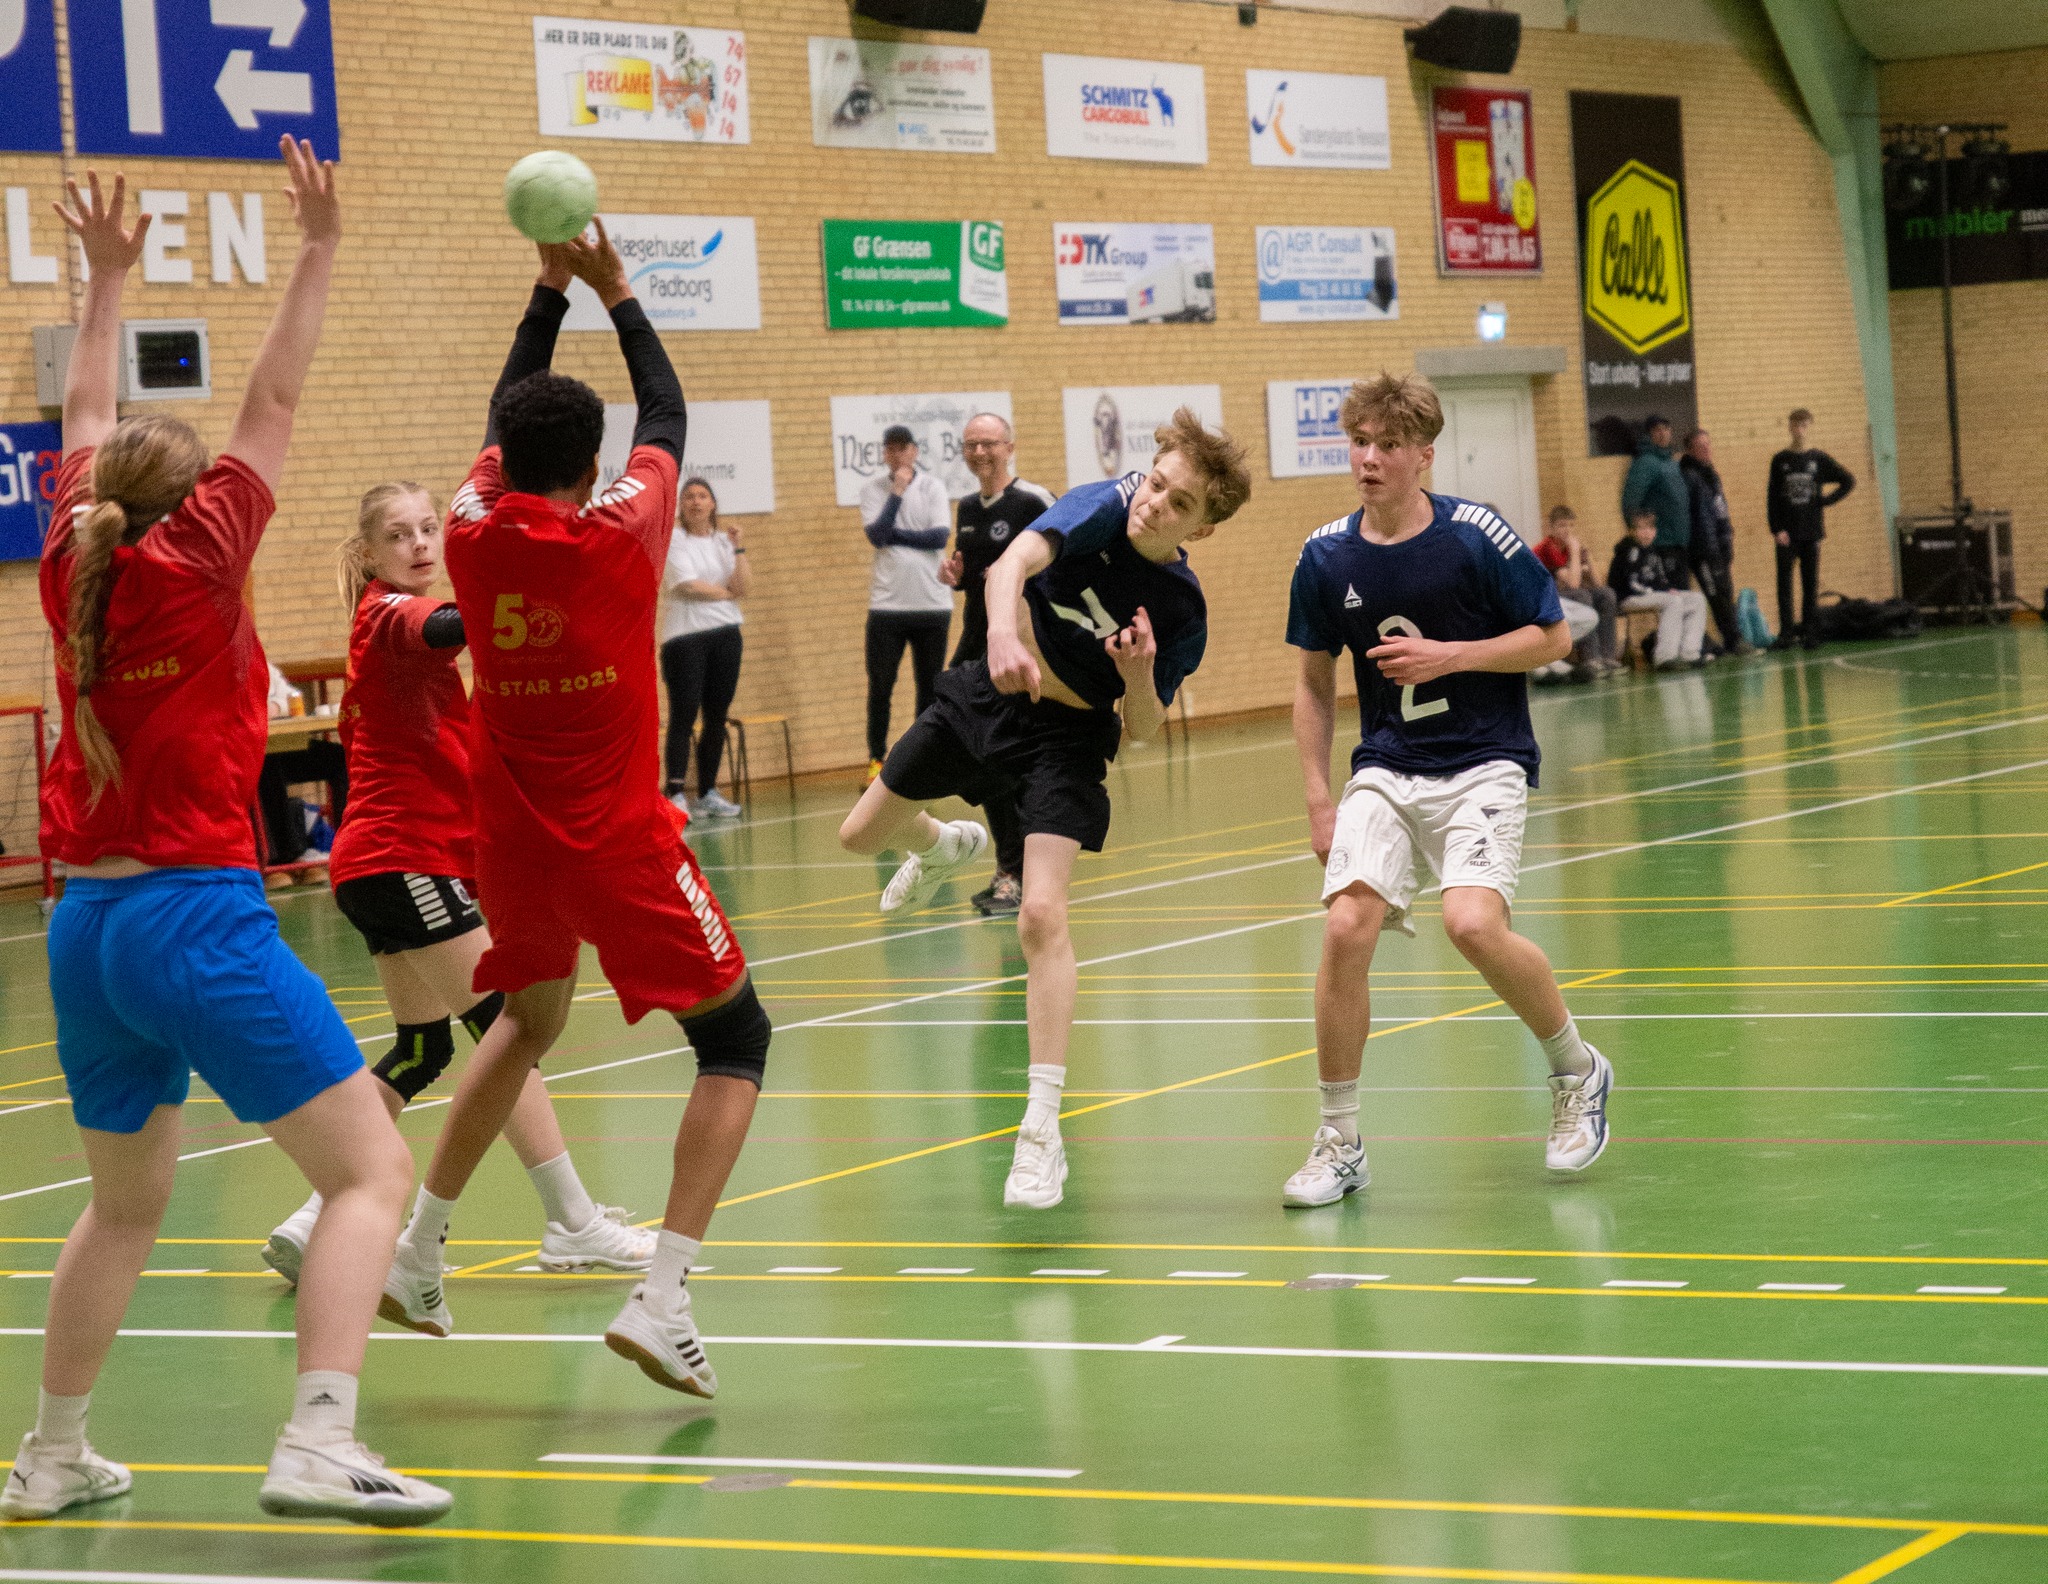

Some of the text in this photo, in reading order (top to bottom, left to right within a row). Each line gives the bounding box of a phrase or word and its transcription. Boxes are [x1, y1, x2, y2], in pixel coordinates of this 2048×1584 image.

[567, 31, 580, 45] ER
[582, 31, 600, 46] DER
[603, 33, 632, 49] PLADS
[635, 34, 649, 49] TIL
[651, 35, 668, 50] DIG
[586, 70, 651, 96] REKLAME
[1081, 84, 1149, 109] SCHMITZ
[1082, 106, 1150, 126] CARGOBULL
[6, 187, 267, 284] LEN
[854, 235, 871, 259] GF
[972, 224, 1003, 259] GF
[1286, 231, 1313, 252] AGR
[1318, 231, 1362, 253] Consult
[1111, 247, 1148, 270] Group
[650, 274, 713, 303] Padborg
[499, 679, 551, 697] STAR
[559, 665, 618, 694] 2025
[1376, 614, 1450, 723] 2
